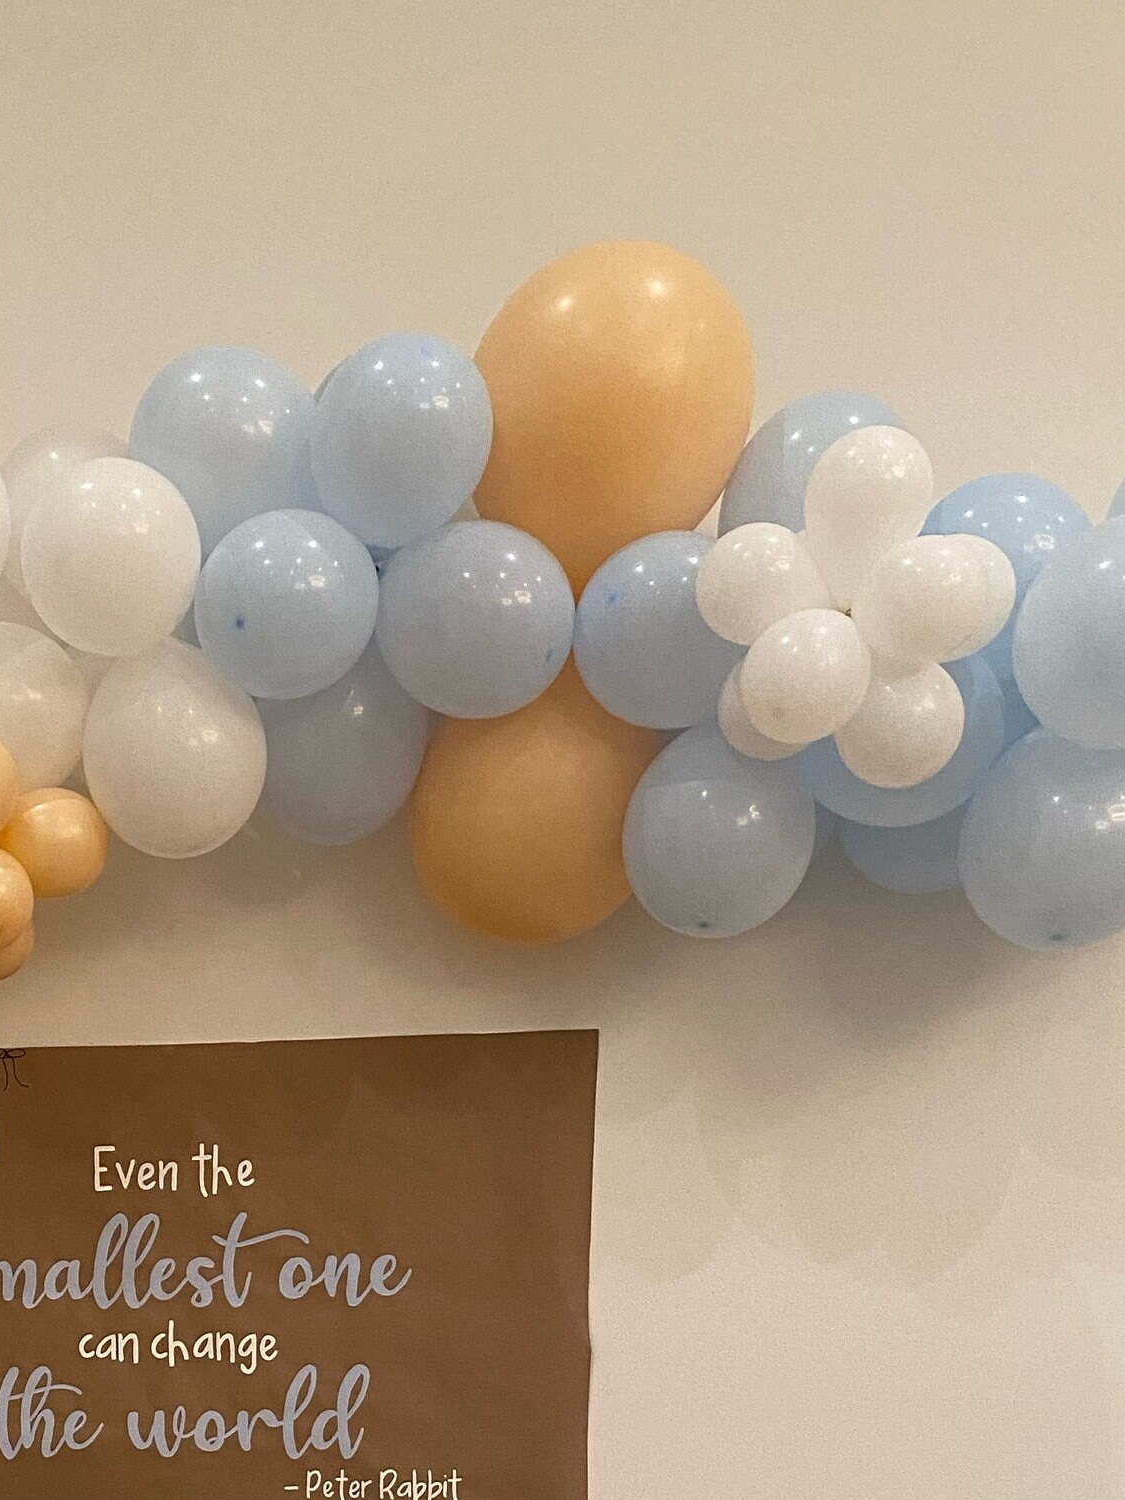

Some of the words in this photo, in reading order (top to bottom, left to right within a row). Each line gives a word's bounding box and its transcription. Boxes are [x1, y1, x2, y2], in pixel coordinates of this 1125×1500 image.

[93, 1145, 178, 1192] Even
[191, 1142, 255, 1198] the
[278, 1252, 413, 1307] one
[78, 1332, 140, 1365] can
[150, 1319, 279, 1375] change
[127, 1363, 371, 1460] world
